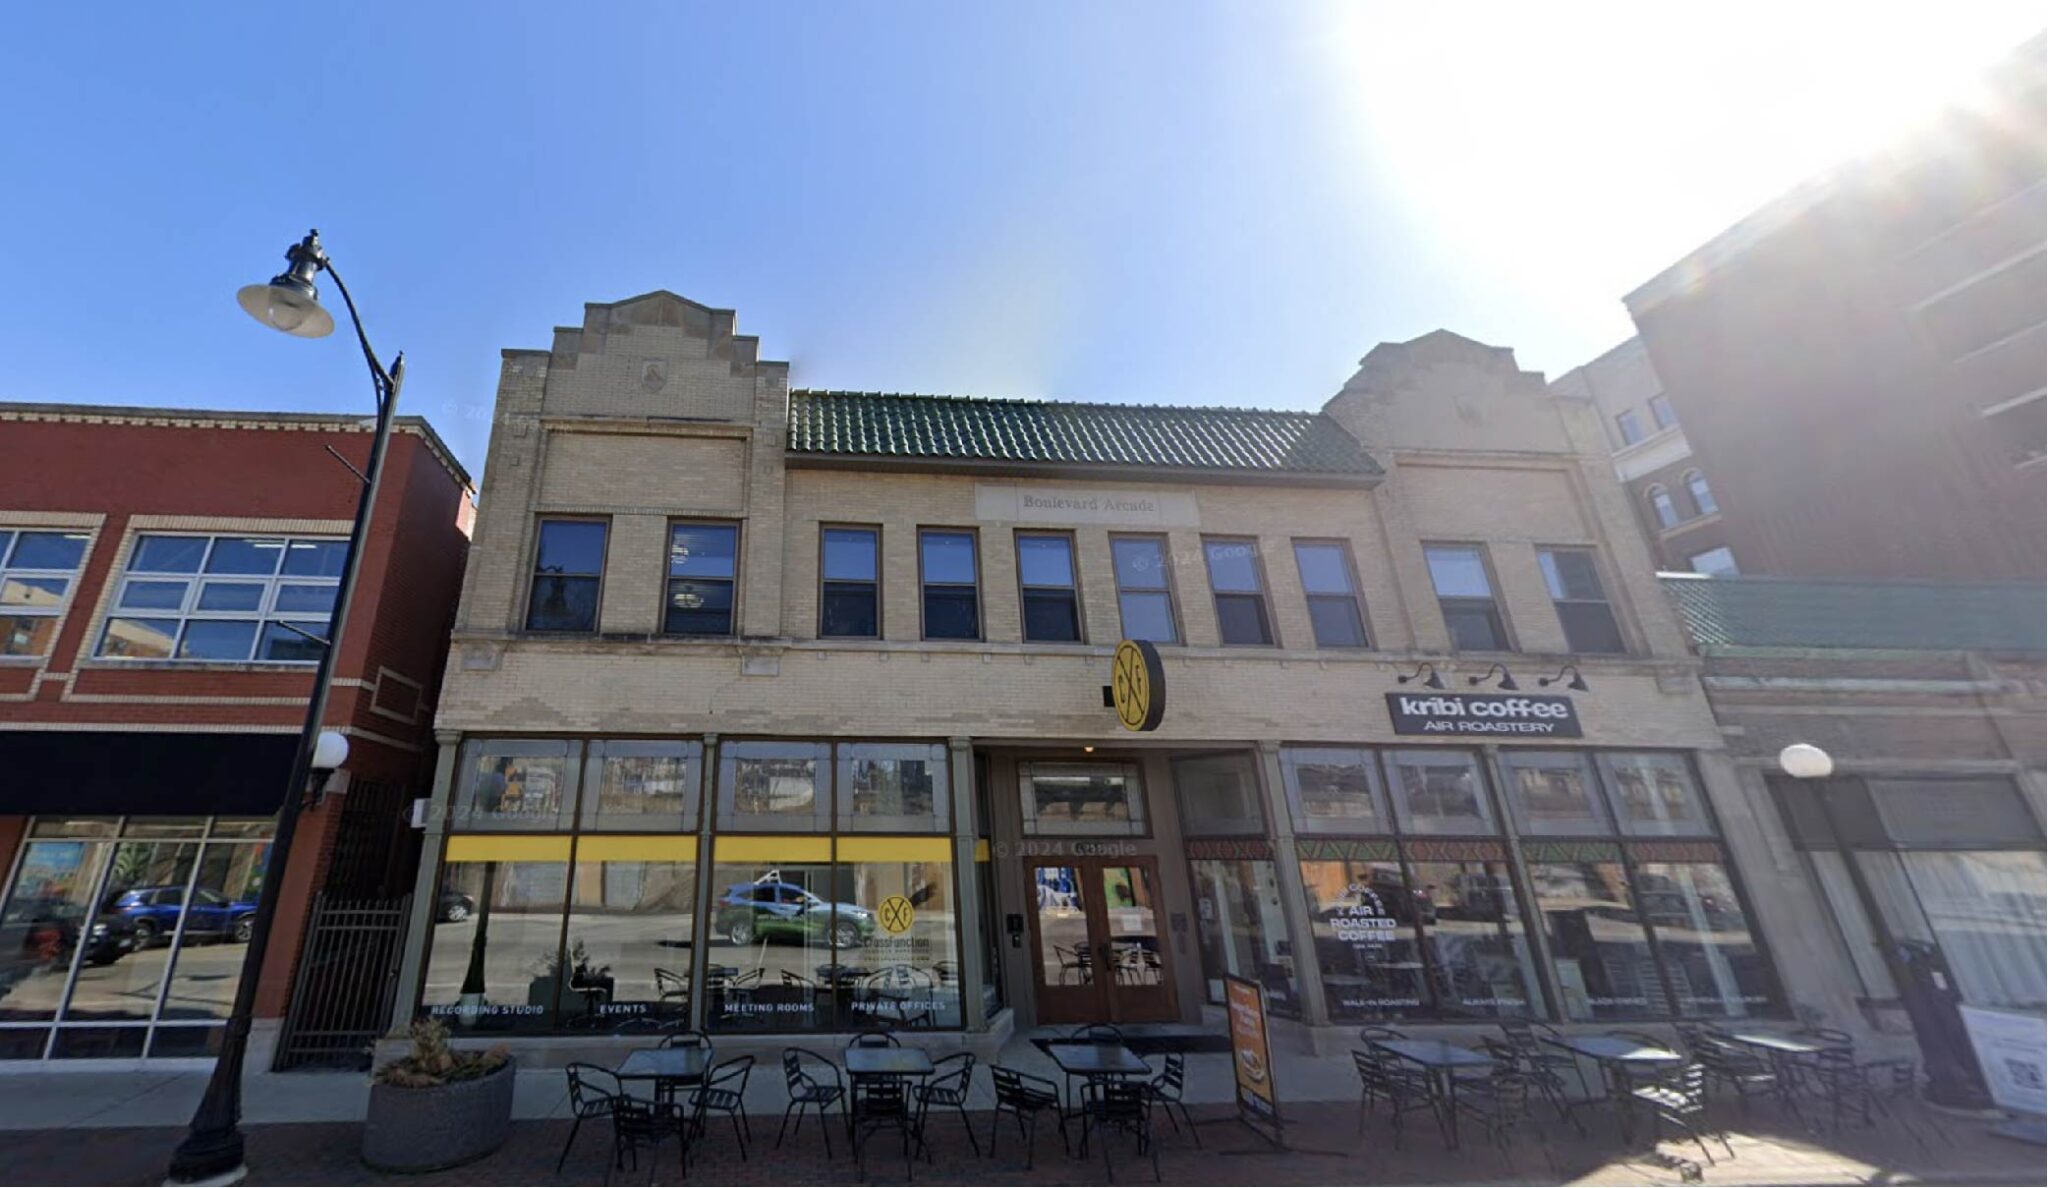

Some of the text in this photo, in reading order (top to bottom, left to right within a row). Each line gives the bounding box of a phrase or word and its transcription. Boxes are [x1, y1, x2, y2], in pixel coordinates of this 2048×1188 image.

[1023, 494, 1154, 512] Boulevard Arcade
[1400, 697, 1568, 718] kribi coffee
[1423, 720, 1555, 733] AIR ROASTERY
[1349, 905, 1374, 916] AIR
[1330, 917, 1397, 928] ROASTED
[1338, 929, 1396, 942] COFFEE
[431, 1004, 544, 1015] RECORDING STUDIO
[600, 1003, 647, 1014] EVENTS
[724, 1002, 815, 1013] MEETING ROOMS
[851, 1000, 946, 1012] PRIVATE OFFICES
